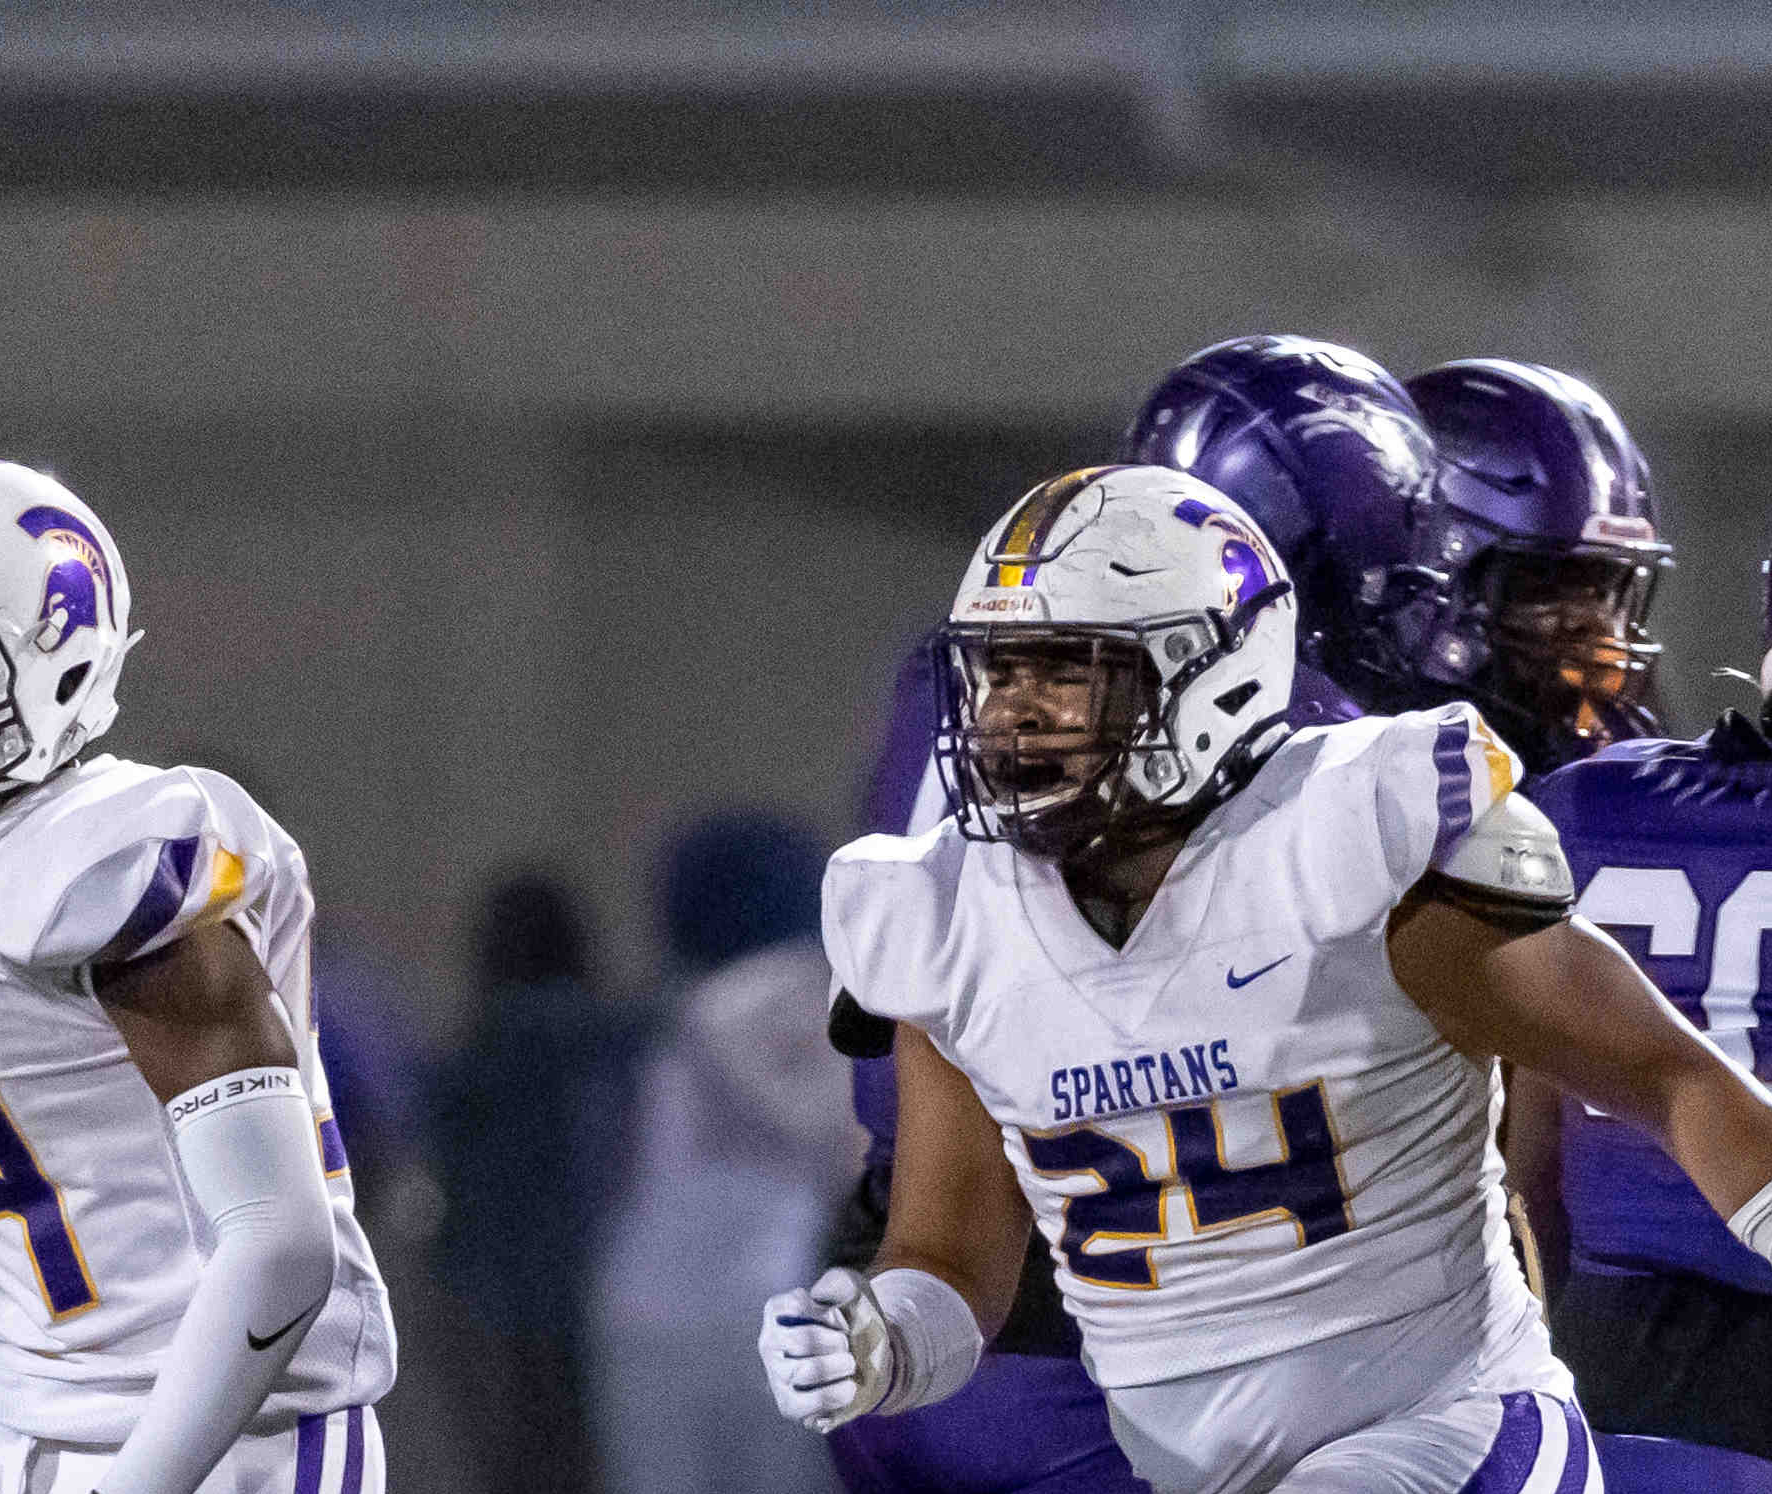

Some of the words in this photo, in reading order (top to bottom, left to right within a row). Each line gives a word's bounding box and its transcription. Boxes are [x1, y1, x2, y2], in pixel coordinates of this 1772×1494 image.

[171, 1088, 219, 1122] PRO
[226, 1073, 290, 1098] NIKE
[1051, 1038, 1239, 1121] SPARTANS
[1019, 1076, 1357, 1290] 24
